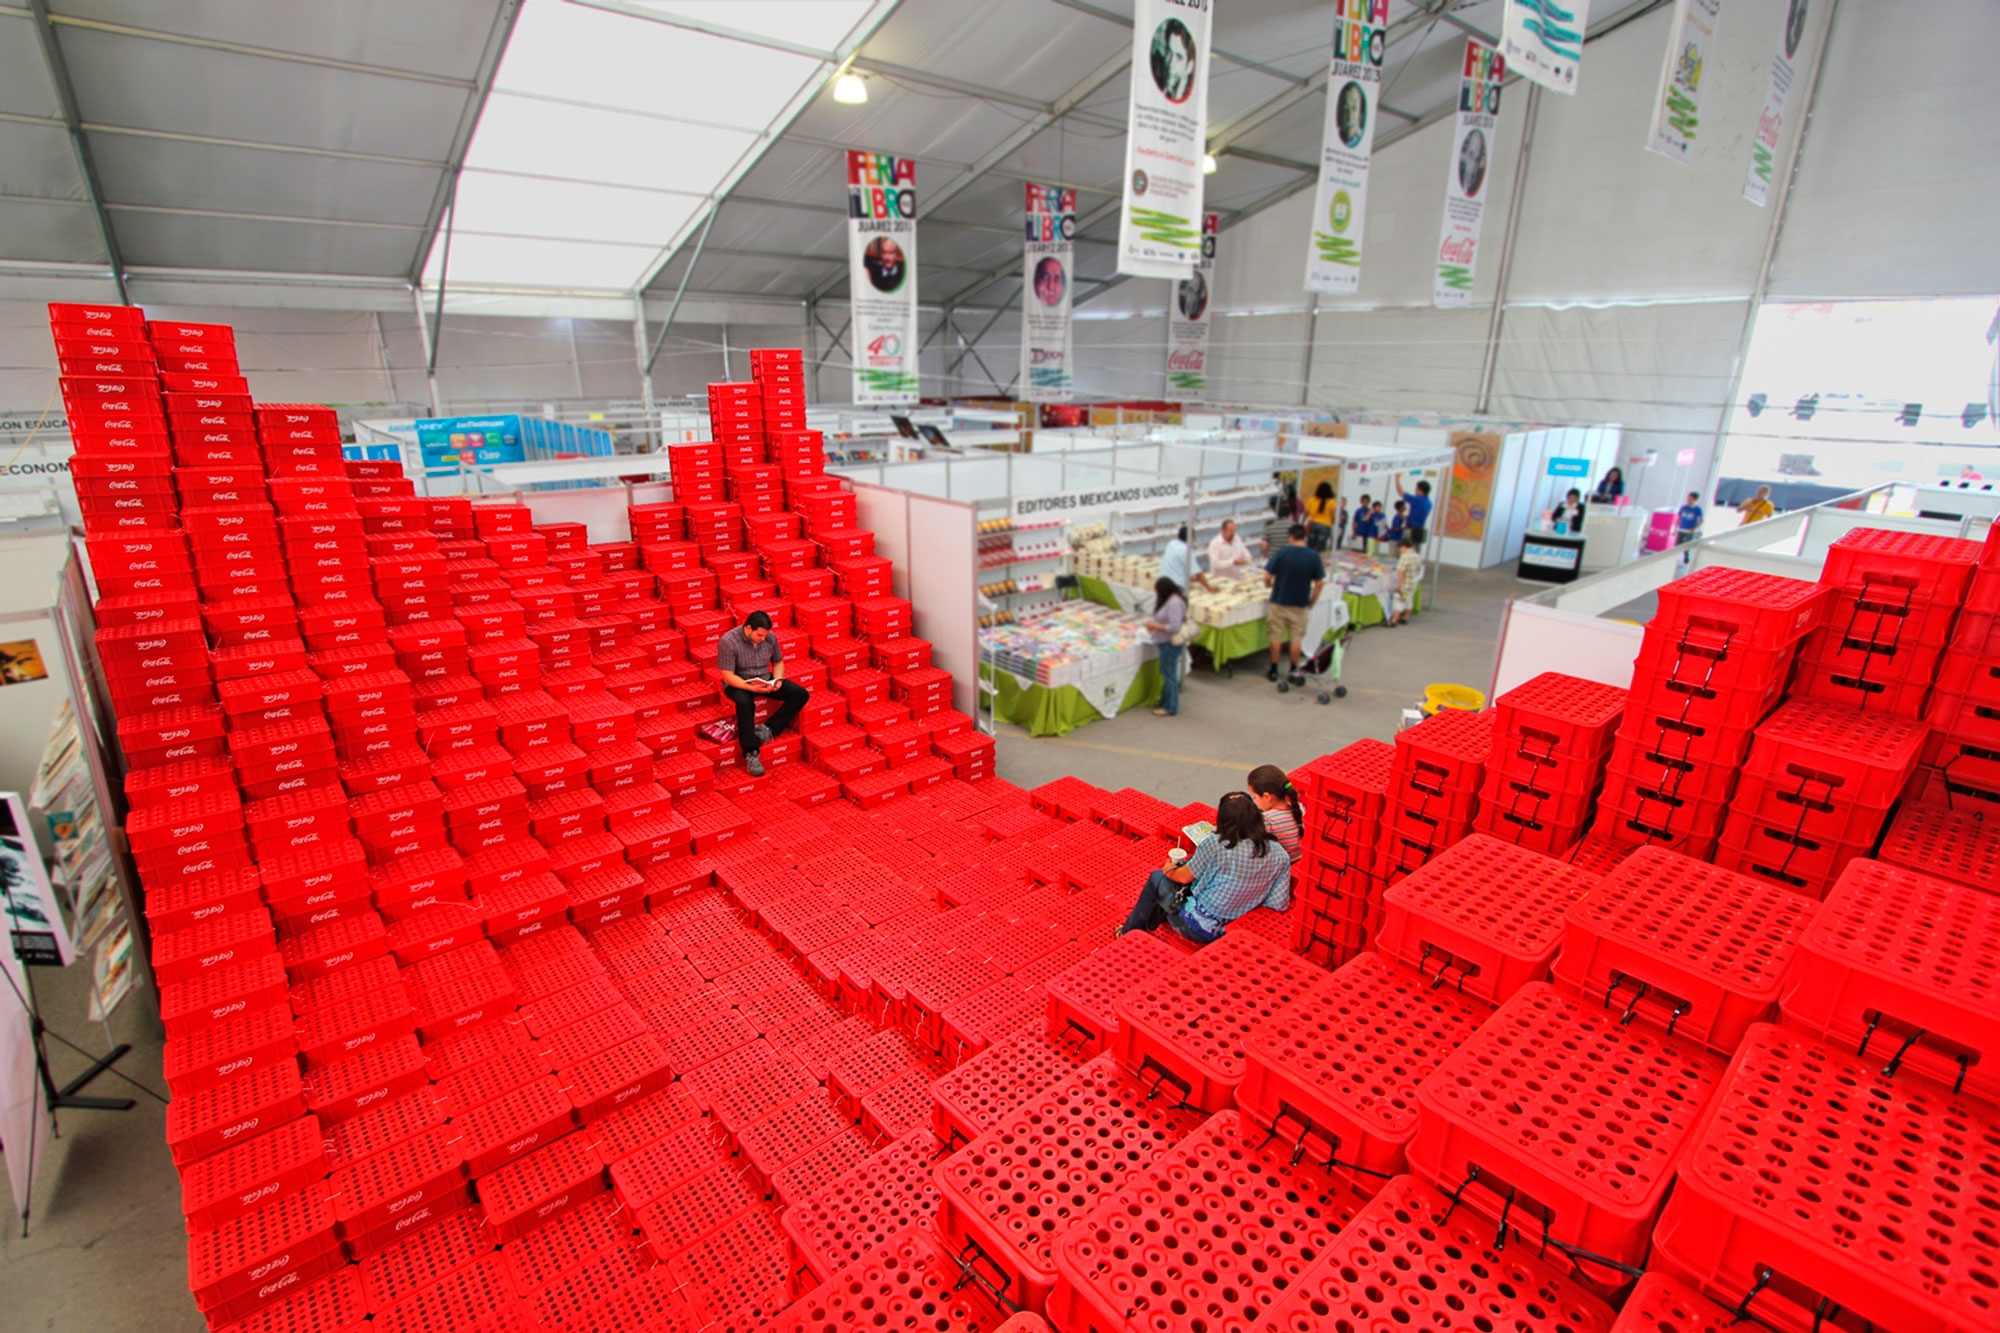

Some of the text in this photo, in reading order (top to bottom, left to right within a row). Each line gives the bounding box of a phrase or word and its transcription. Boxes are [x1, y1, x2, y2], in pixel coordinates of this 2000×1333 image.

[847, 150, 916, 187] FERIA
[849, 187, 917, 219] LIBRO
[1025, 182, 1076, 213] FERIA
[1026, 214, 1076, 241] LIBRO
[0, 421, 22, 430] ON
[1018, 483, 1180, 514] EDITORES MEXICANOS UNIDOS
